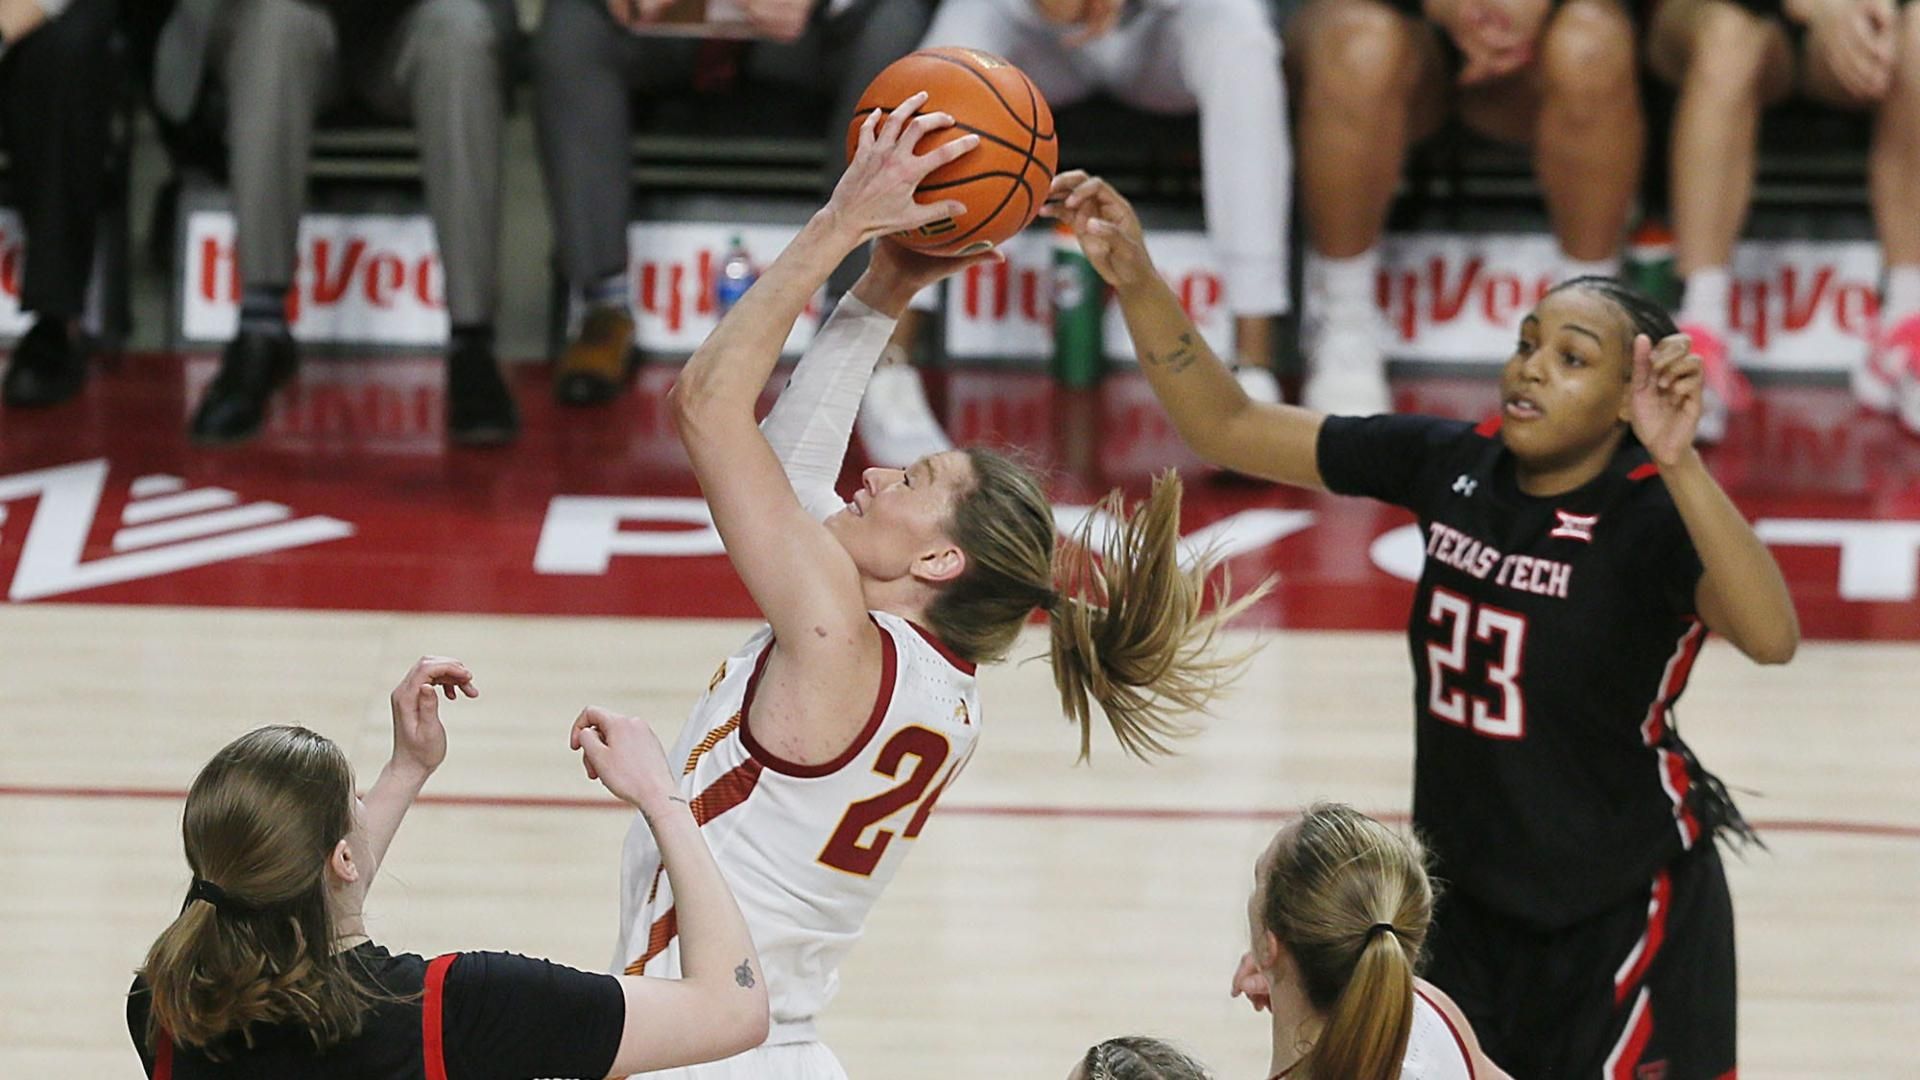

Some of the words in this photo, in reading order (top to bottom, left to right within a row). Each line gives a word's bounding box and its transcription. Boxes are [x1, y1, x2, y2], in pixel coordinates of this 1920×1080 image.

[1426, 521, 1501, 579] TEXAS
[1495, 554, 1573, 599] TECH
[1425, 584, 1528, 741] 23
